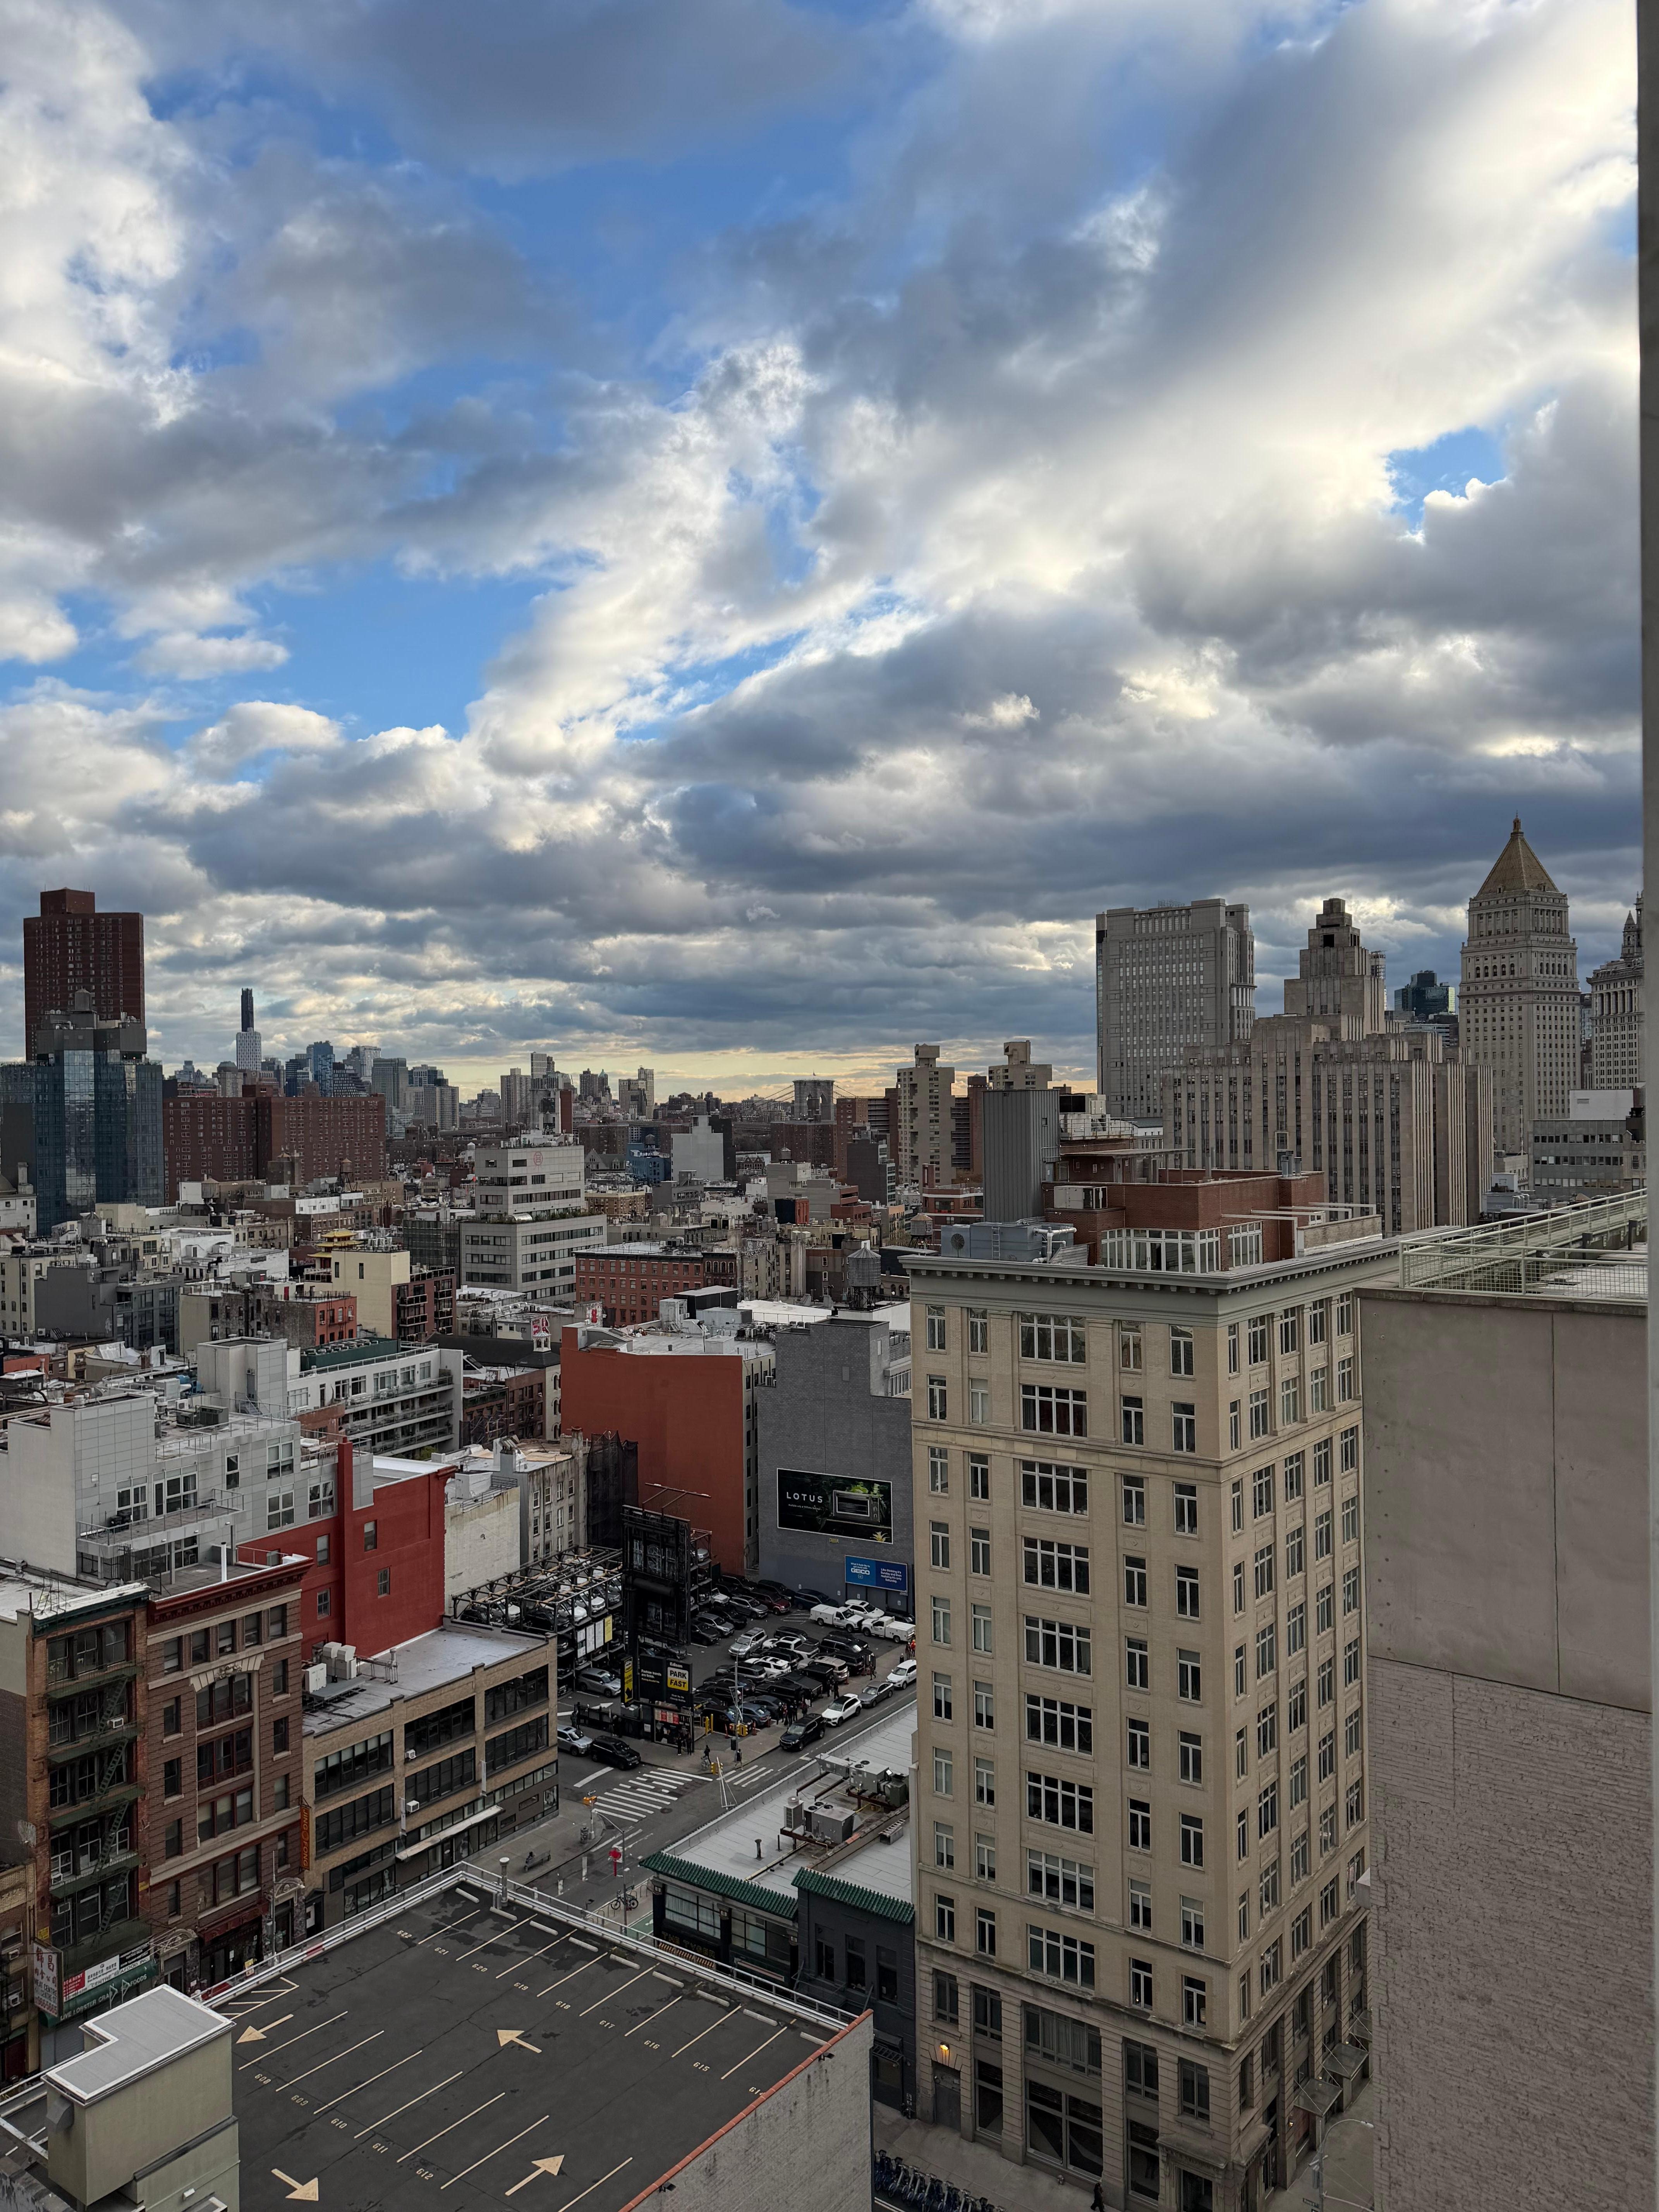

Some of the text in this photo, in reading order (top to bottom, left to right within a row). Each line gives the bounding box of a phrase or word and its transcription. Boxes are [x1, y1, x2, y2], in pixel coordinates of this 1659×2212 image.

[787, 1492, 823, 1503] LOTUS
[670, 1670, 687, 1679] PARK
[670, 1680, 686, 1688] FAST
[397, 1930, 412, 1938] 622
[661, 1931, 680, 1944] THE
[472, 1963, 488, 1972] 620
[514, 1982, 529, 1990] 619
[555, 2001, 571, 2009] 618
[60, 2011, 72, 2020] LIVE
[73, 2000, 96, 2014] LOBSTER
[599, 2020, 615, 2029] 617
[644, 2040, 660, 2049] 616
[693, 2062, 710, 2071] 615
[254, 2074, 271, 2084] 608
[291, 2095, 309, 2106] 609
[331, 2118, 347, 2129] 610
[372, 2143, 388, 2154] 611
[416, 2168, 434, 2180] 612
